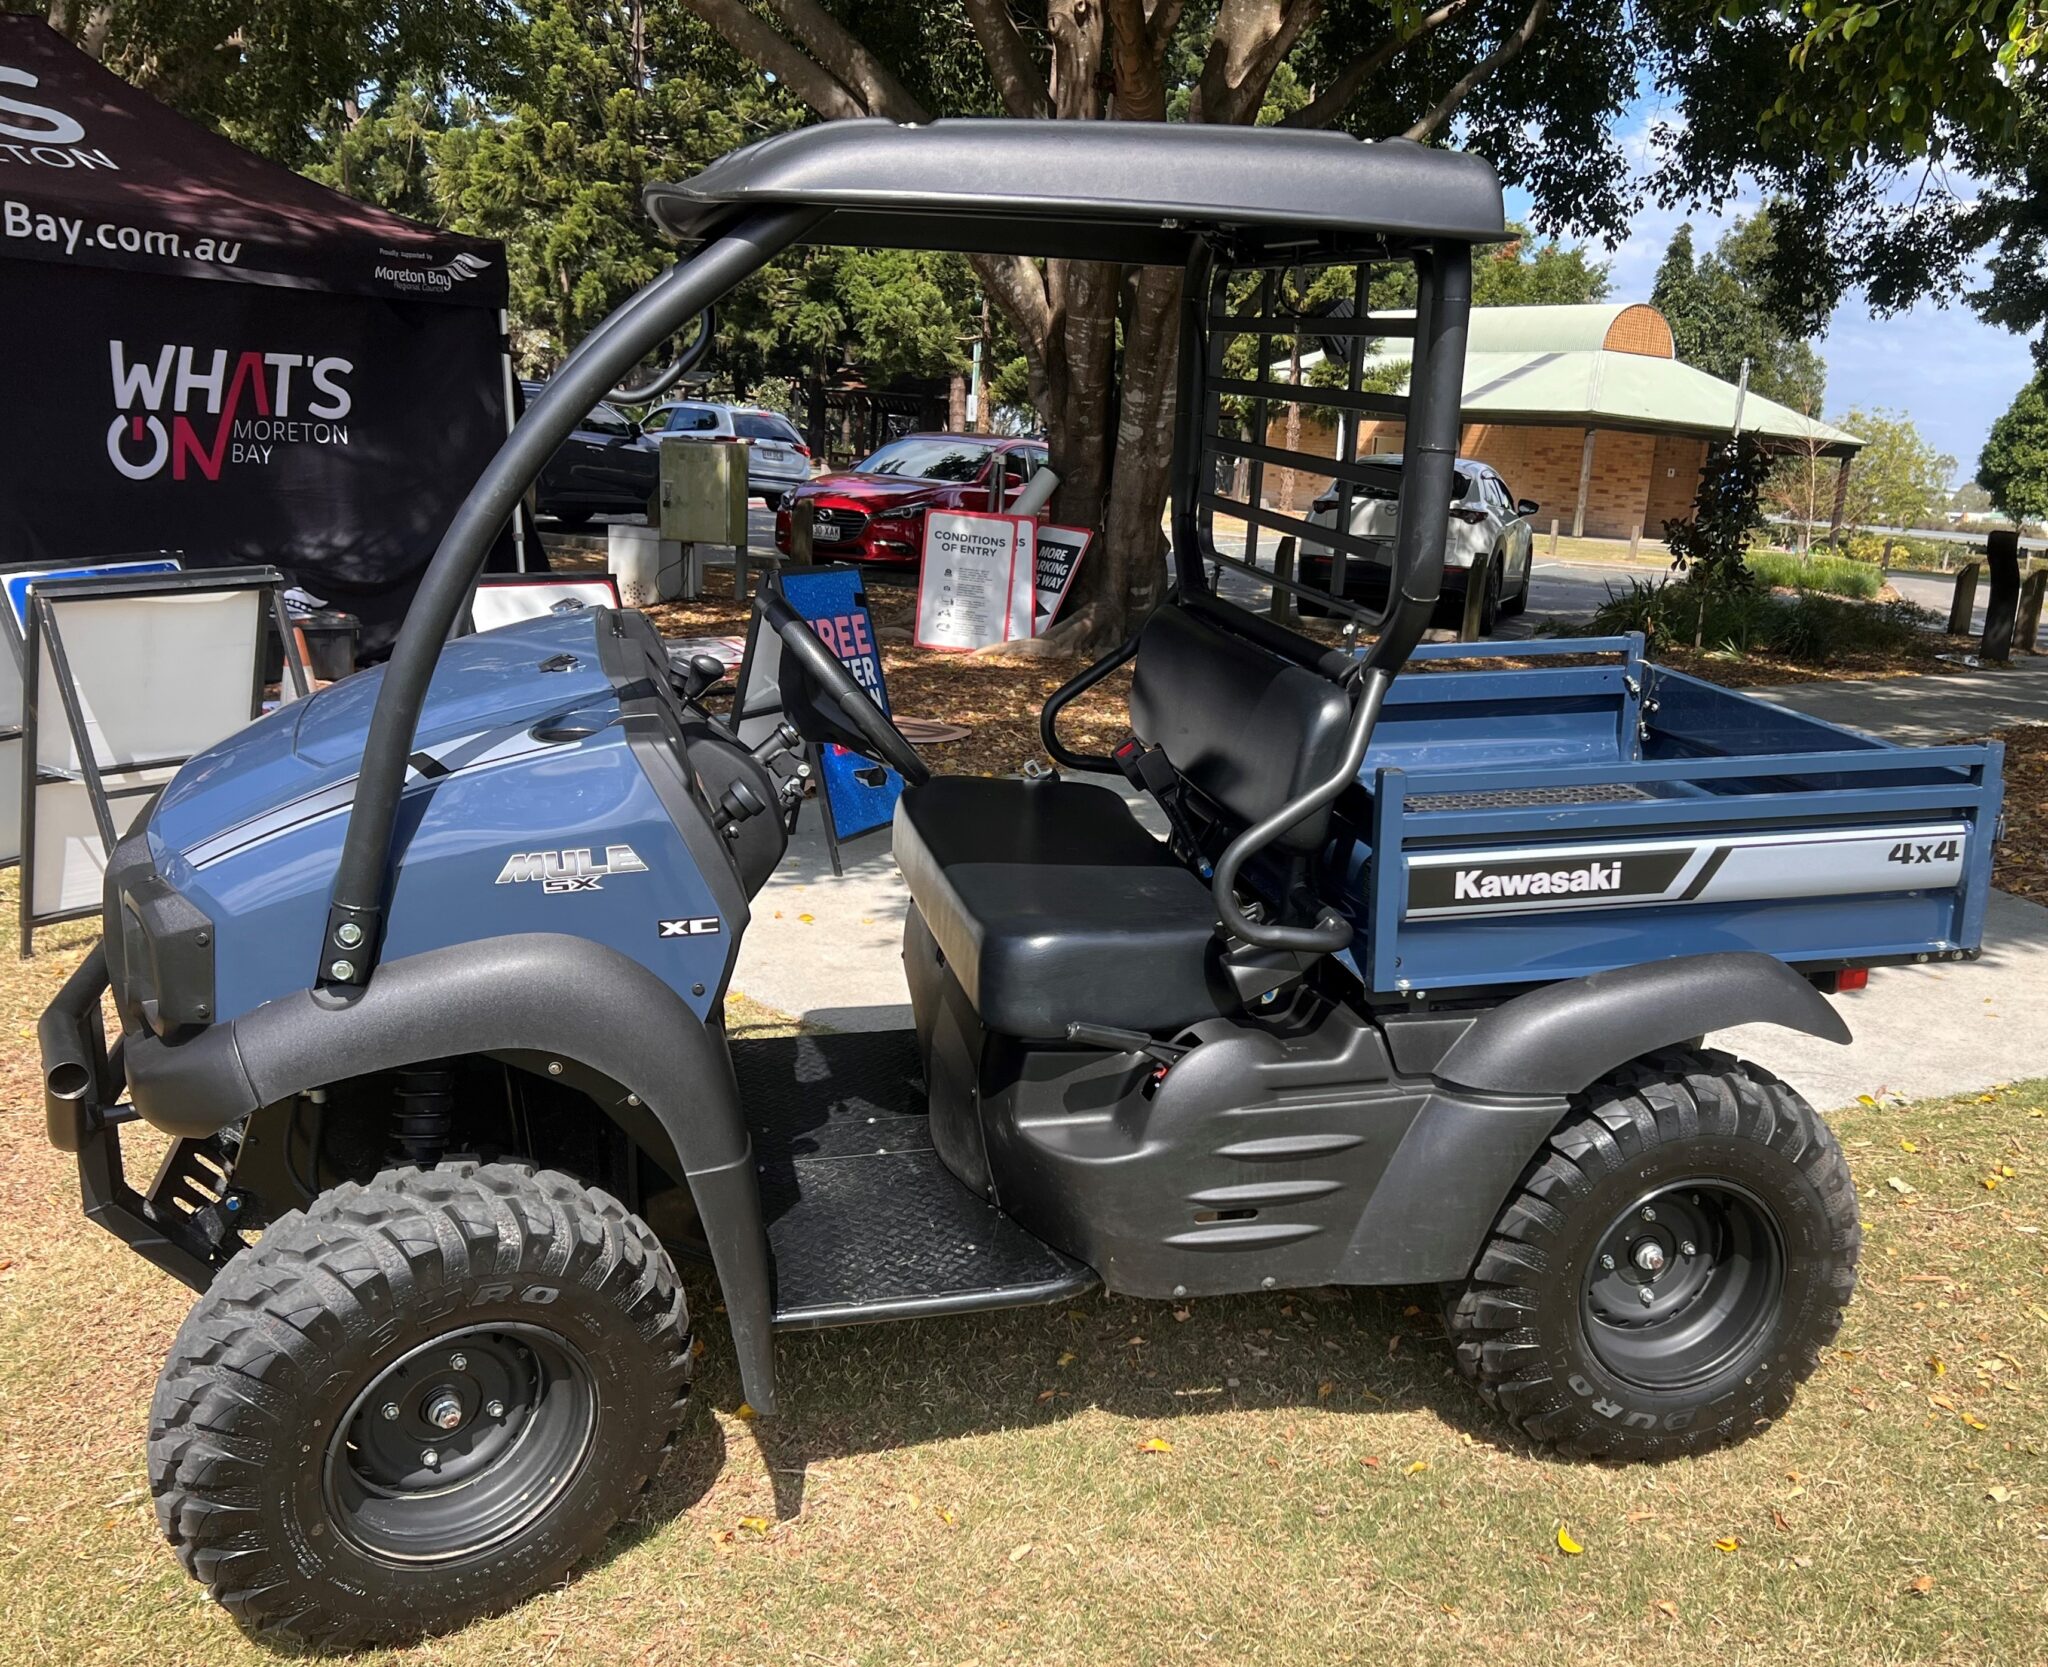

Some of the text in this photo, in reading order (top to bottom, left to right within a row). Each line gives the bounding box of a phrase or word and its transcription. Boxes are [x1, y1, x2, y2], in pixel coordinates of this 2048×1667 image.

[4, 200, 242, 264] Bay.com.au
[375, 265, 452, 291] Moreton Bay
[394, 280, 445, 293] Regional Council
[109, 339, 354, 420] WHAT'S
[233, 419, 349, 445] MORETON
[106, 414, 230, 481] ON
[231, 443, 273, 464] BAY
[934, 530, 1006, 548] CONDITIONS
[941, 542, 997, 558] OF ENTRY
[1038, 546, 1069, 561] MORE
[1041, 574, 1065, 590] WAY
[807, 614, 871, 659] REE
[846, 656, 878, 687] ER
[495, 844, 649, 885] MULE
[1887, 840, 1960, 865] 4x4
[543, 876, 604, 894] SX
[1453, 861, 1622, 900] Kawasaki
[659, 917, 719, 937] XC
